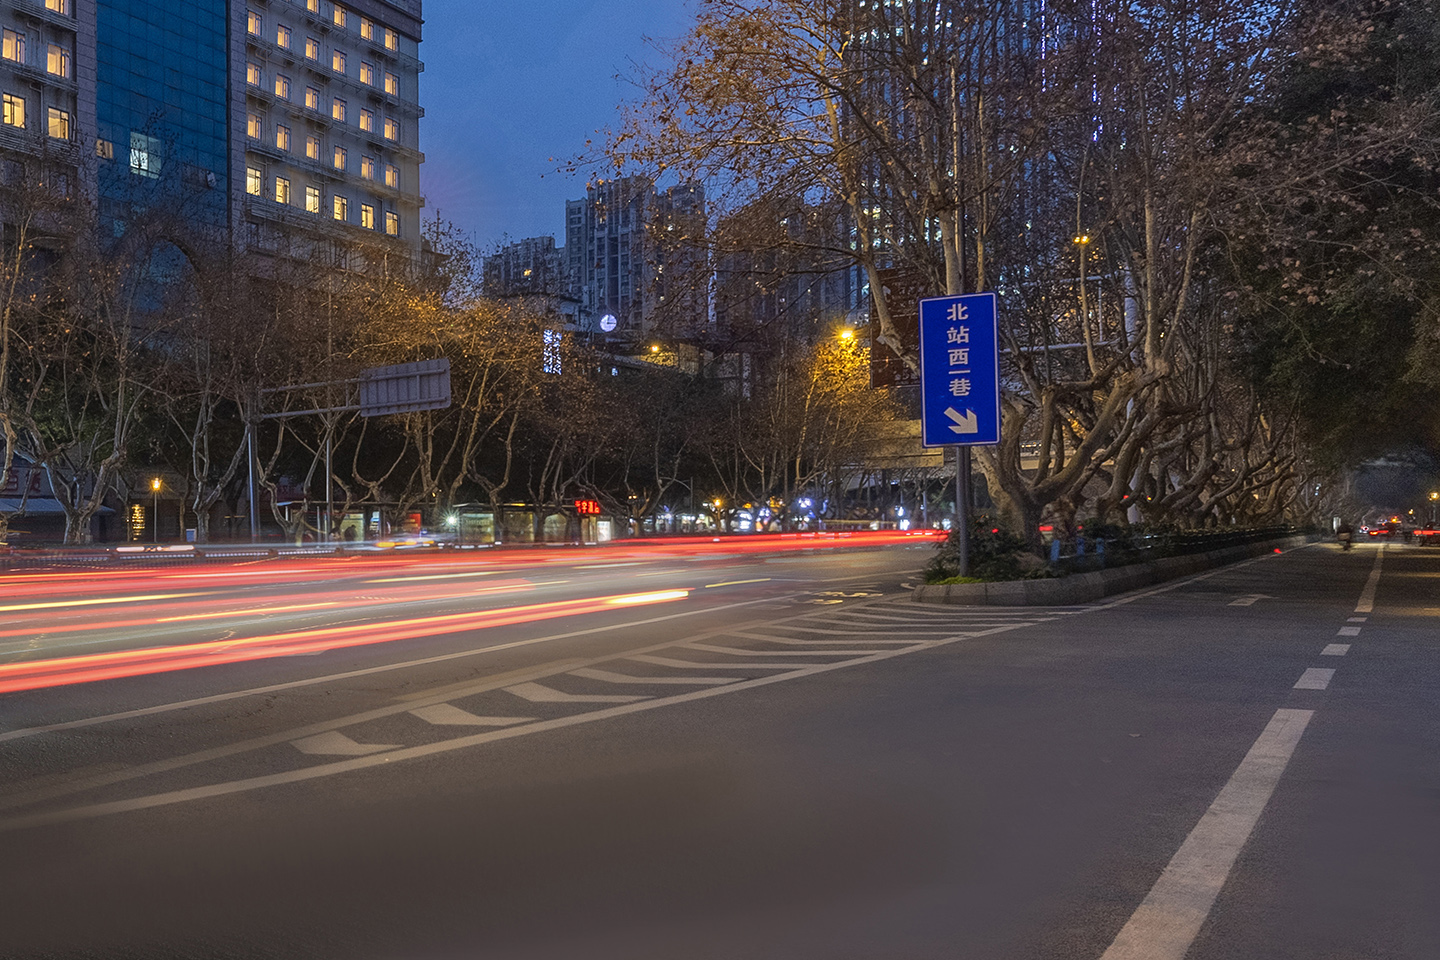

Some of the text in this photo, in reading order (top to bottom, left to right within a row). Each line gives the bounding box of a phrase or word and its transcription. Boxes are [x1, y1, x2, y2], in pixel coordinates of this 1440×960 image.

[946, 302, 972, 398] 北站西一巷
